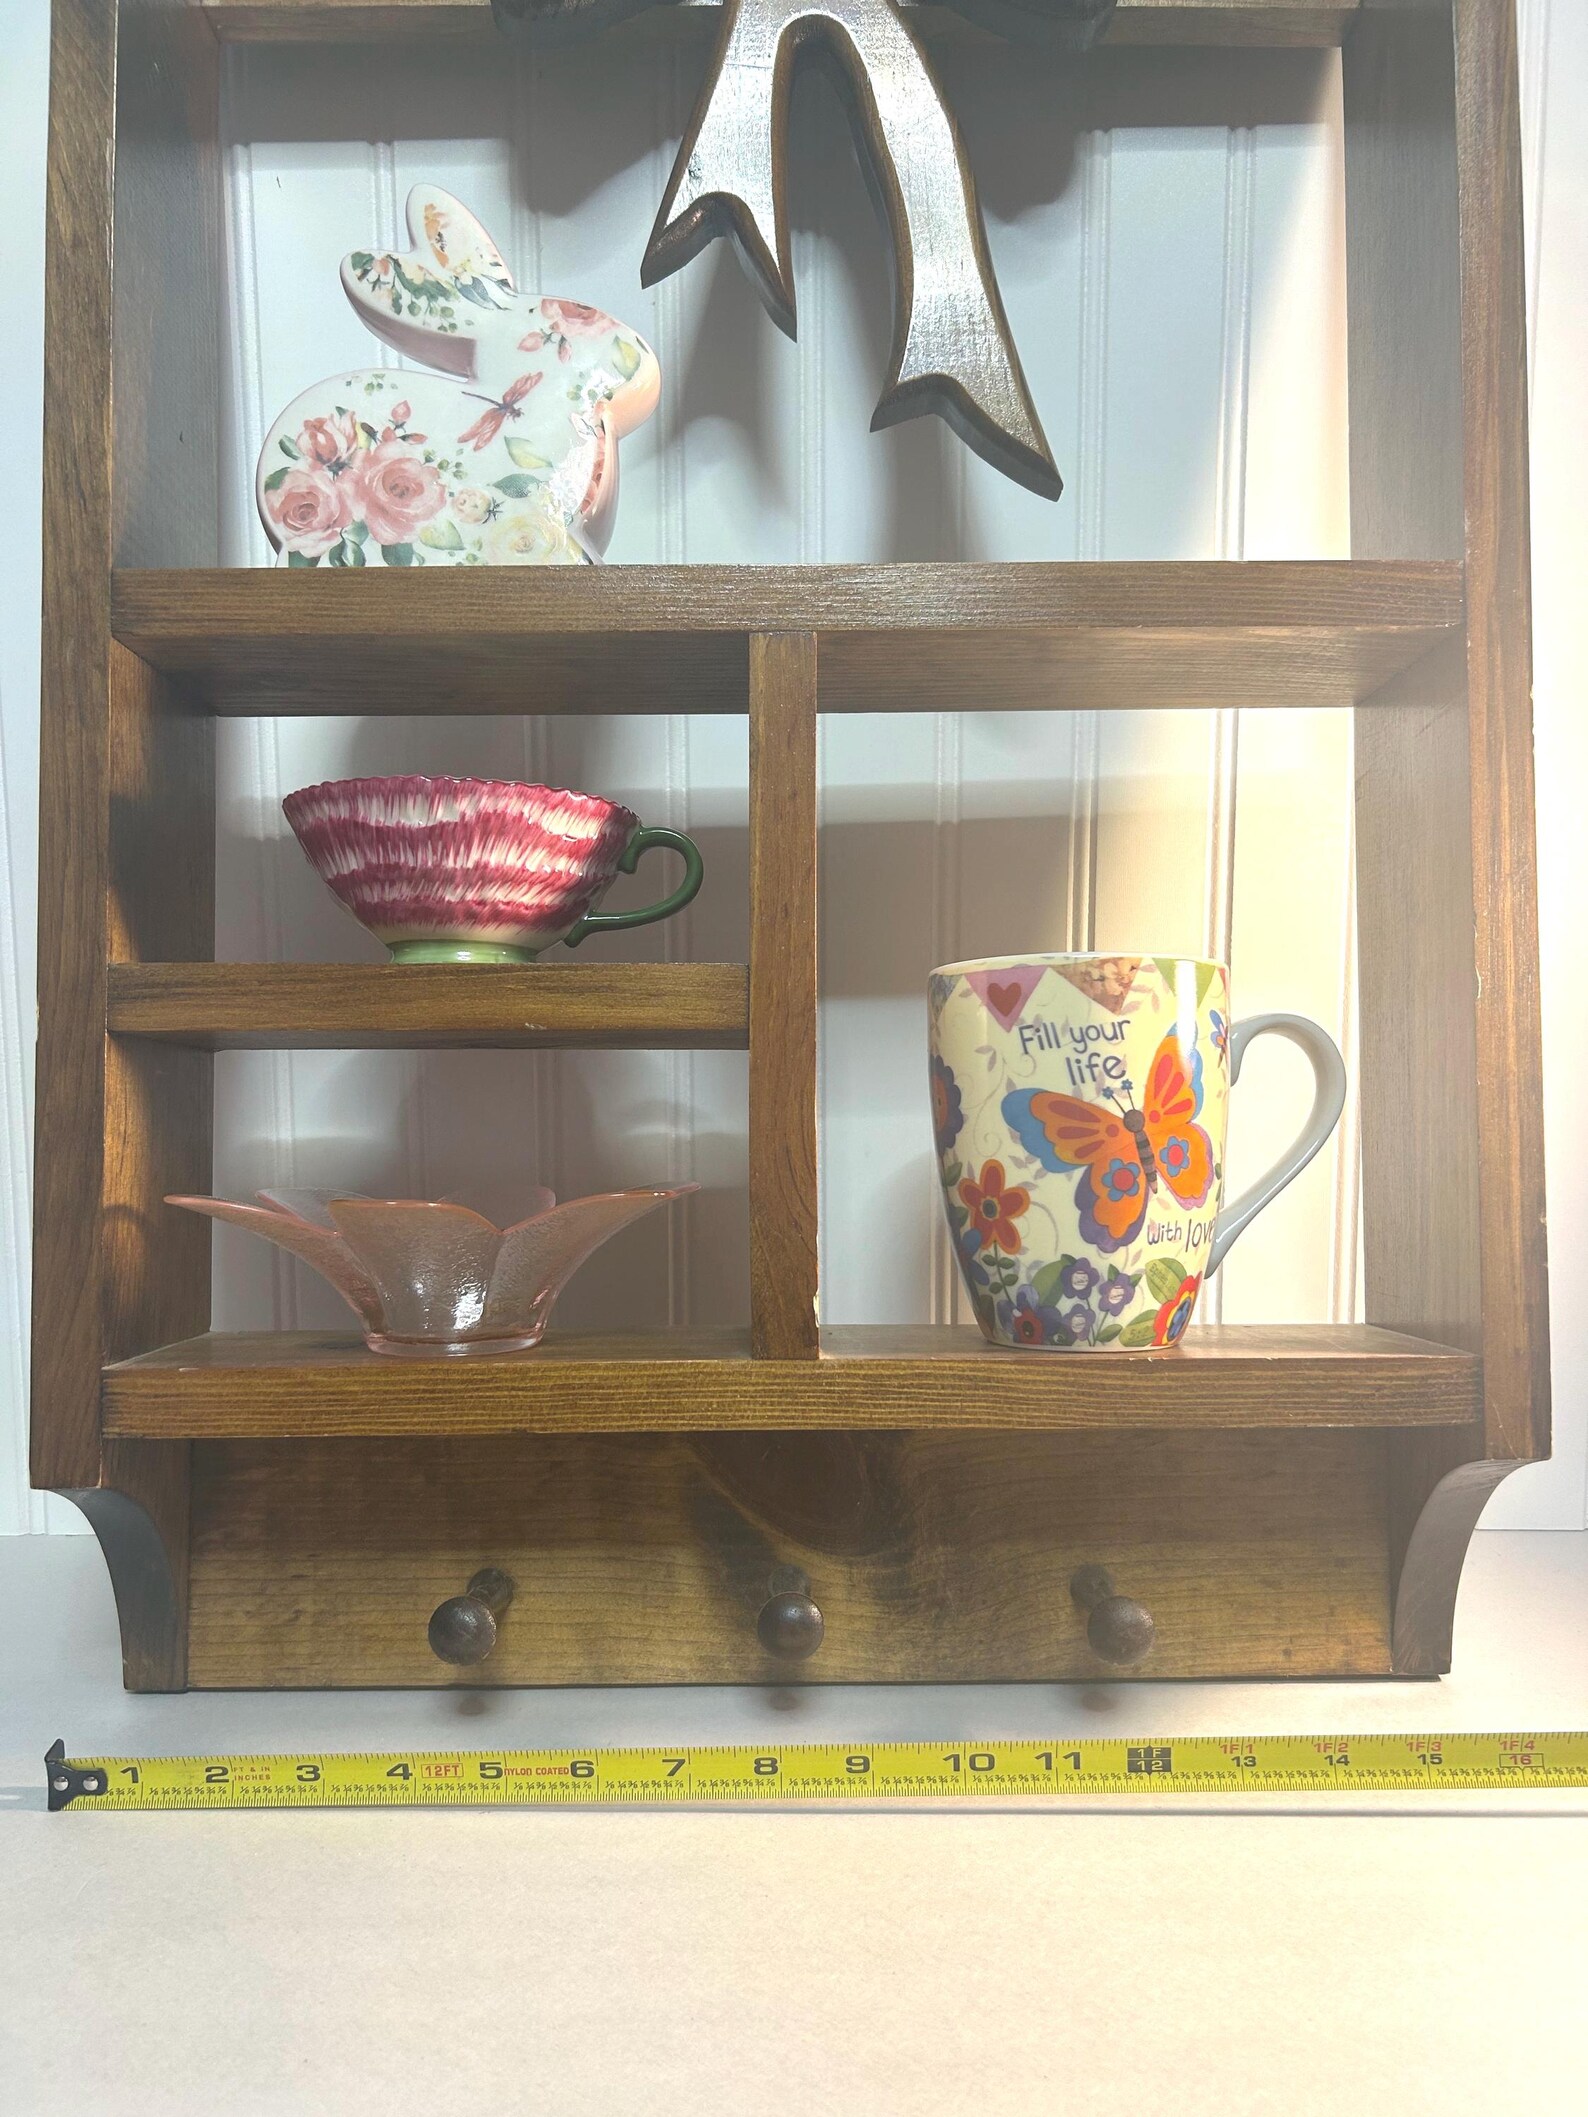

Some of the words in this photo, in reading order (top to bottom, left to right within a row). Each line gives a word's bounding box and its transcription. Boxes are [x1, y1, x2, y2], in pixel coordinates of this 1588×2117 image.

[1018, 1022, 1061, 1055] Fill
[1069, 1020, 1131, 1054] your
[1065, 1052, 1126, 1086] life
[121, 1766, 139, 1784] 1
[205, 1767, 229, 1783] 2
[297, 1765, 320, 1781] 3
[387, 1764, 412, 1780] 4
[480, 1762, 503, 1779] 5
[571, 1761, 594, 1777] 6
[662, 1759, 685, 1776] 7
[754, 1758, 778, 1775] 8
[846, 1756, 870, 1773] 9
[943, 1754, 995, 1771] 10
[1035, 1752, 1080, 1770] 11
[1137, 1761, 1162, 1770] 12
[1232, 1756, 1256, 1767] 13
[1325, 1755, 1350, 1766] 14
[1418, 1754, 1442, 1765] 15
[1509, 1755, 1532, 1765] 16
[234, 1773, 271, 1781] INCHES
[426, 1764, 459, 1777] 12FT
[536, 1767, 569, 1775] COATED
